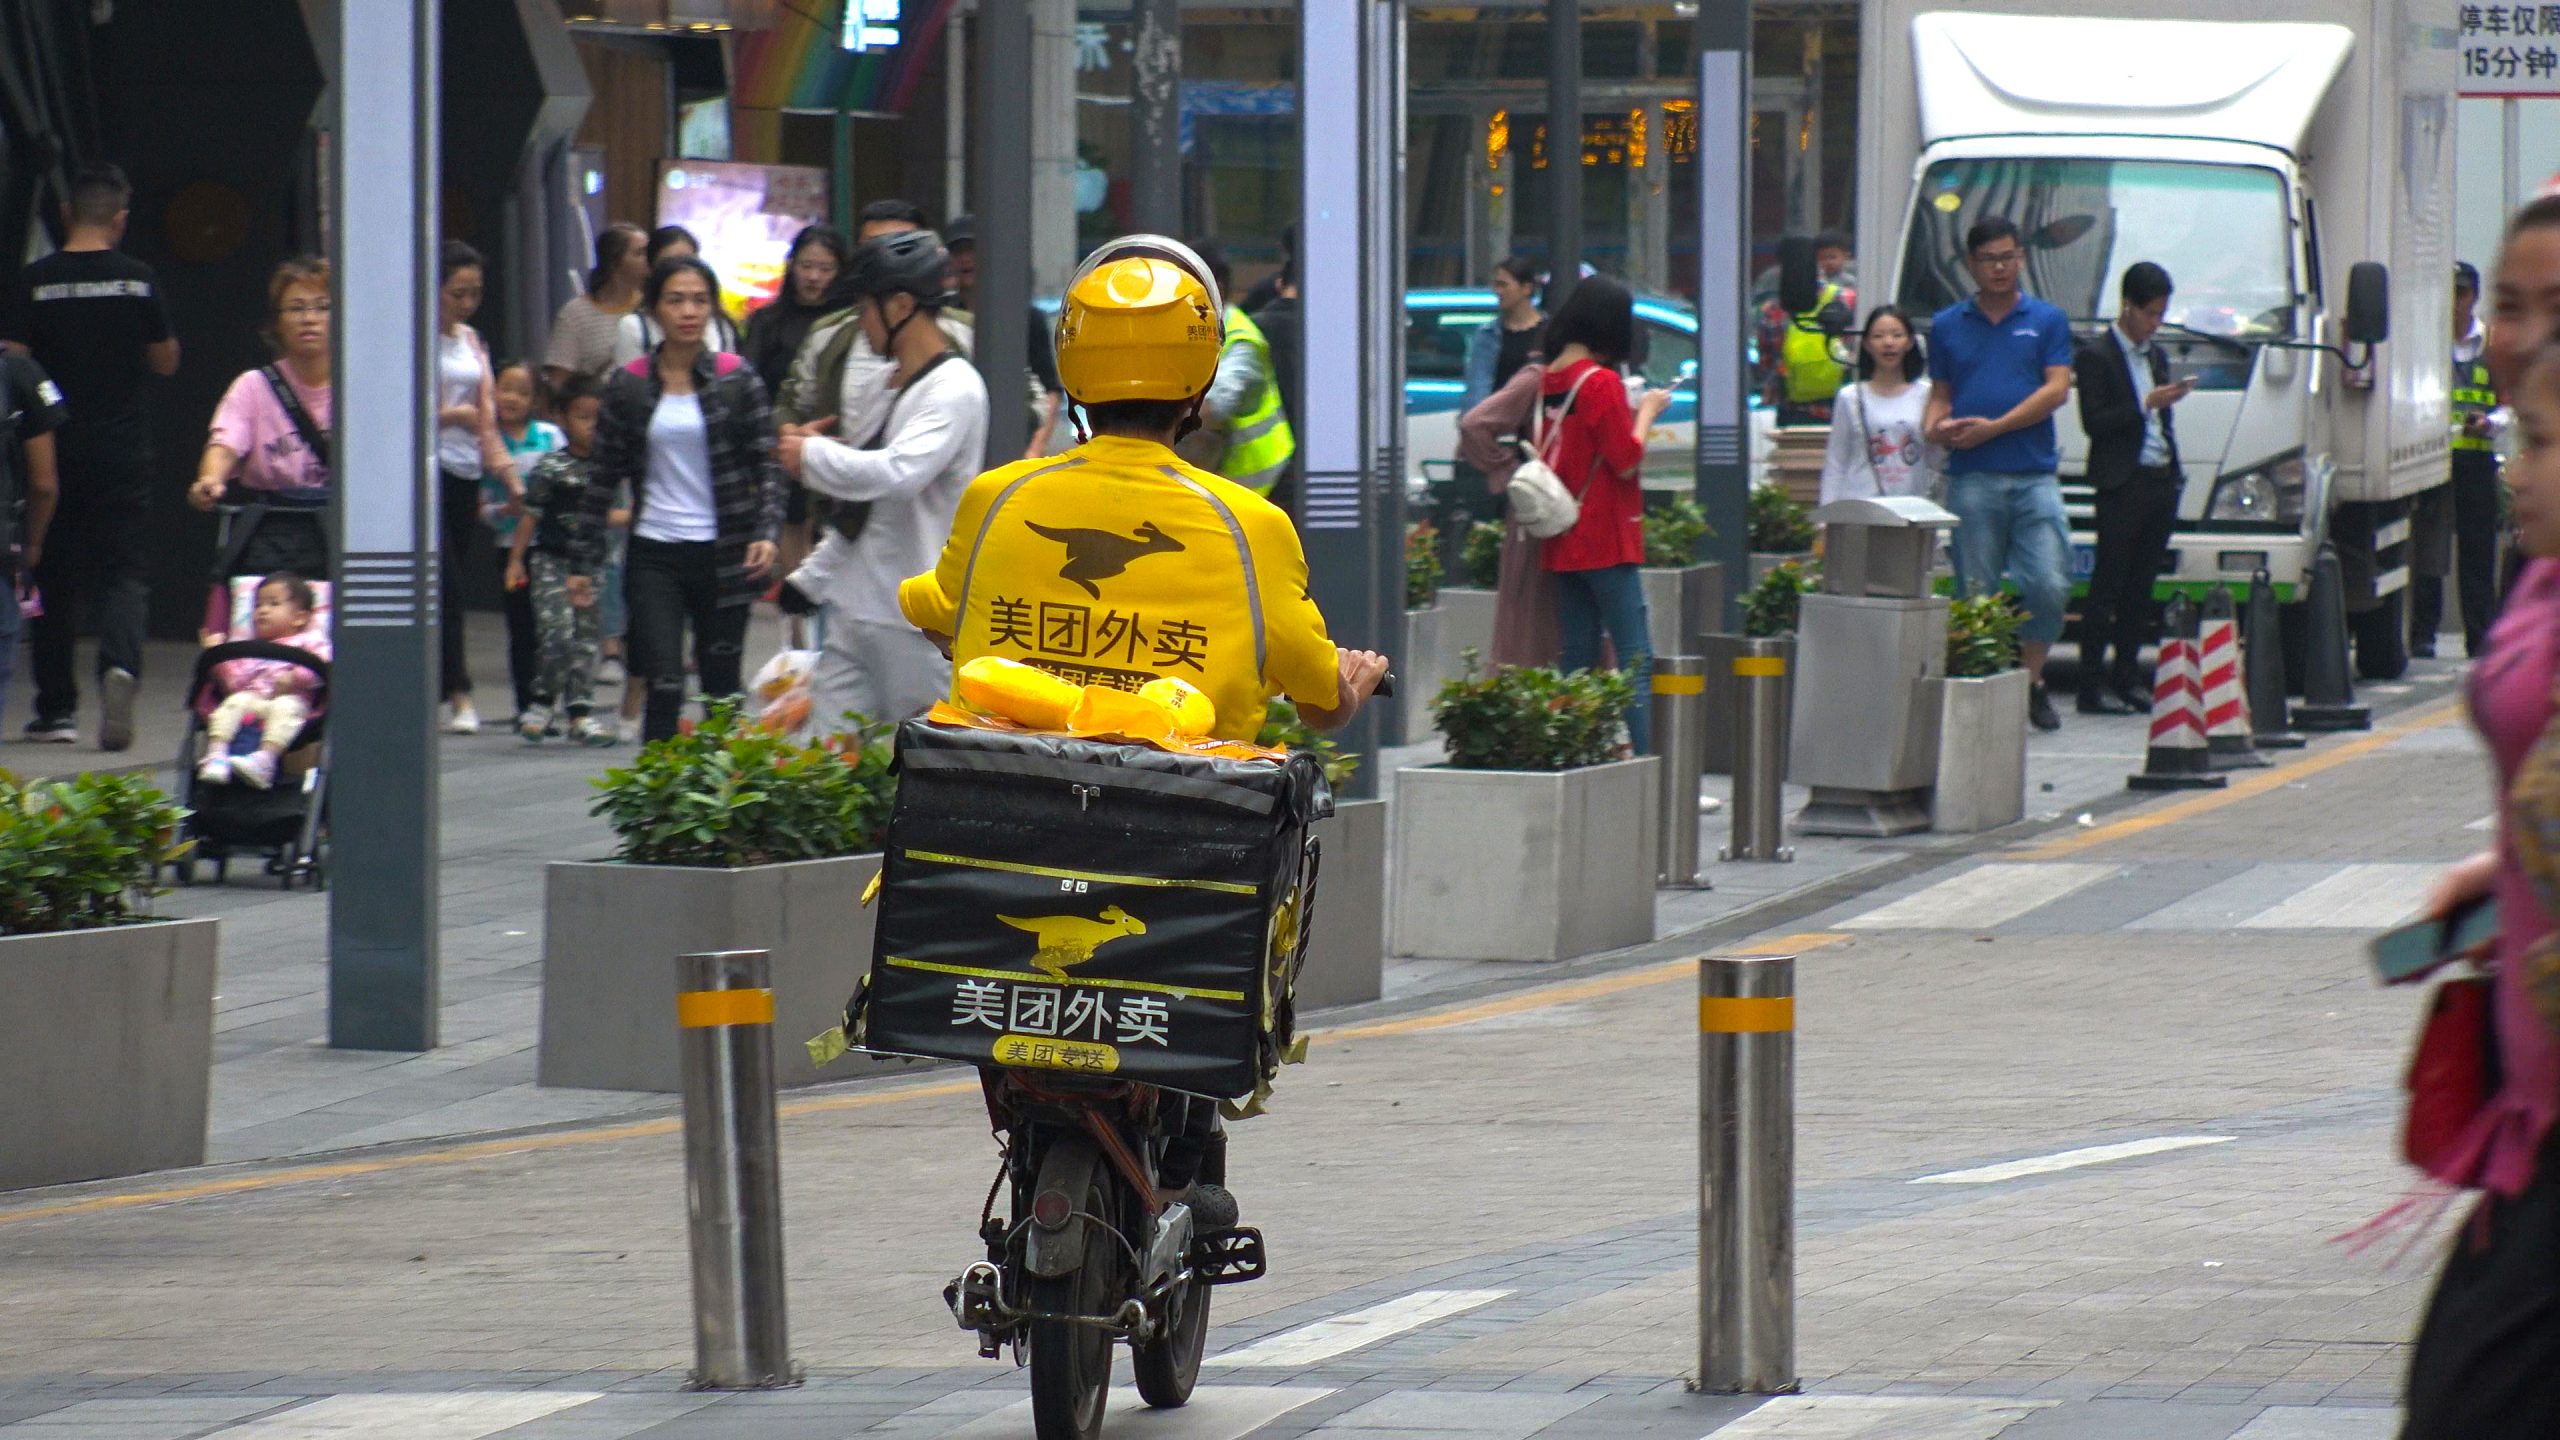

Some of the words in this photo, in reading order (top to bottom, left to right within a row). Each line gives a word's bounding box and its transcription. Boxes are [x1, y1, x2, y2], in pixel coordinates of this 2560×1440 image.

[2460, 5, 2560, 36] 停车仅限
[2463, 46, 2557, 79] 15分钟
[990, 595, 1208, 672] 美团外卖
[951, 979, 1169, 1047] 美团外卖
[1007, 1041, 1105, 1070] 美团专送
